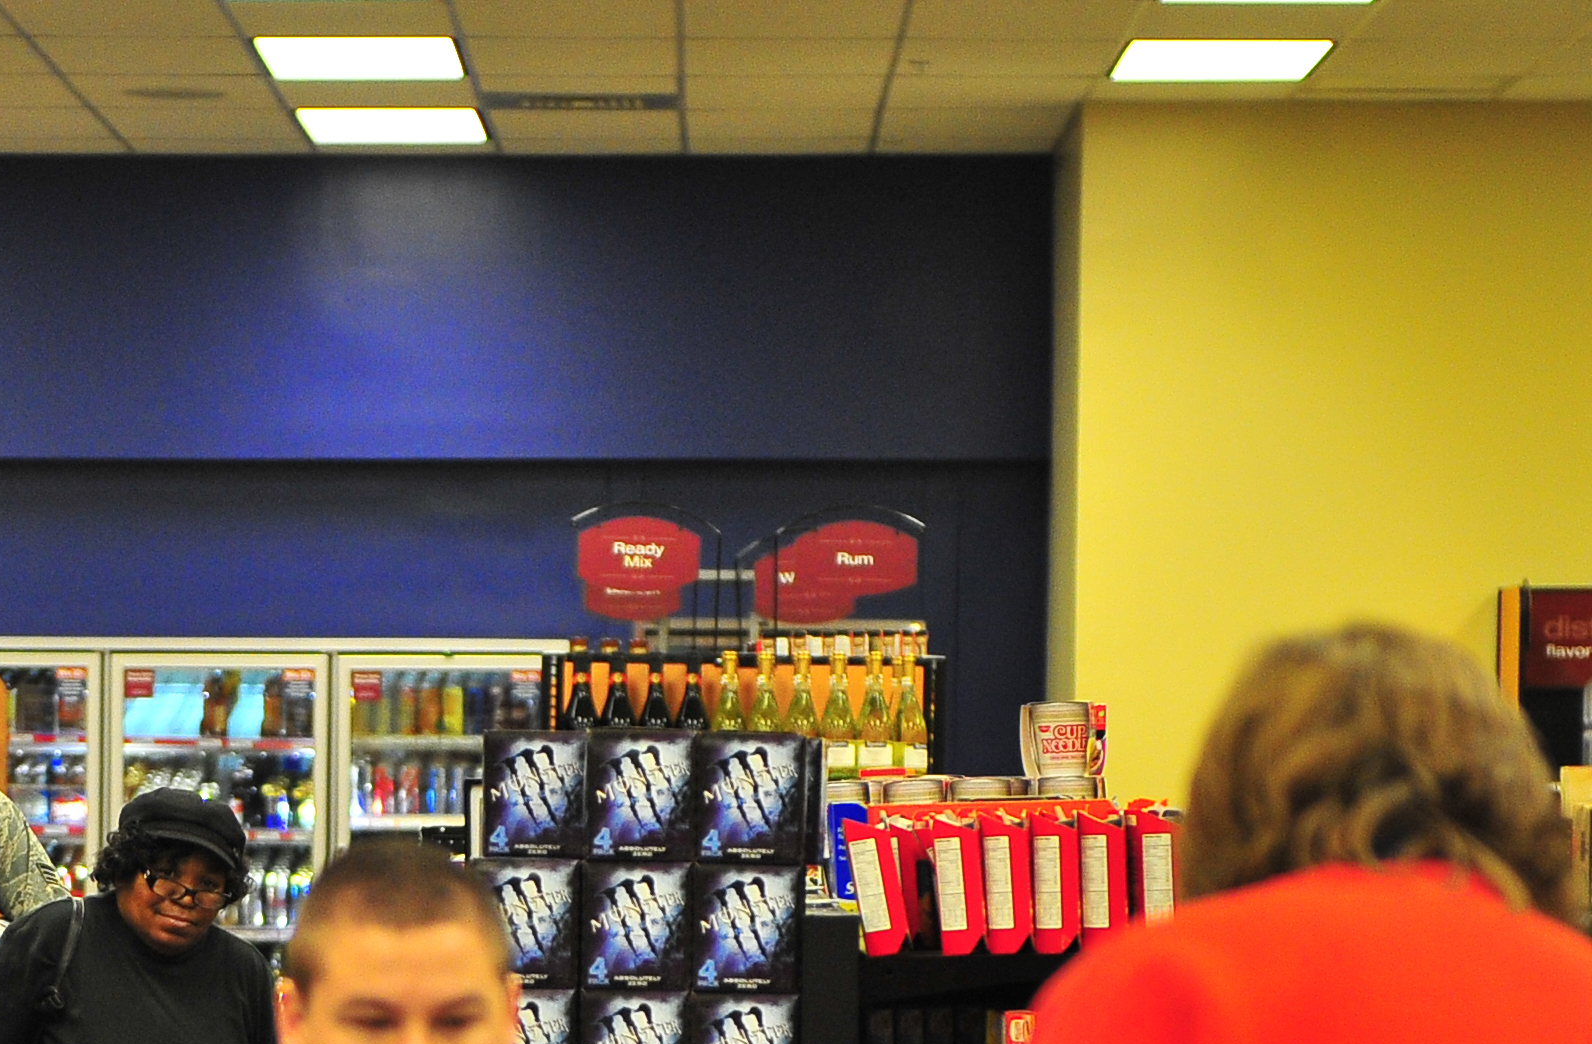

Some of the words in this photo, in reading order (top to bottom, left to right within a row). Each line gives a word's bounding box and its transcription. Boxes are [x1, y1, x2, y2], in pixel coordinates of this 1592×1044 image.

[613, 541, 664, 558] Ready
[836, 552, 874, 566] Rum
[623, 555, 653, 569] Mix
[1053, 725, 1087, 739] CUP
[1041, 738, 1088, 754] NOODLE
[490, 826, 509, 848] 4
[594, 828, 613, 850] 4
[702, 829, 721, 851] 4
[589, 957, 608, 979] 4
[698, 959, 717, 981] 4
